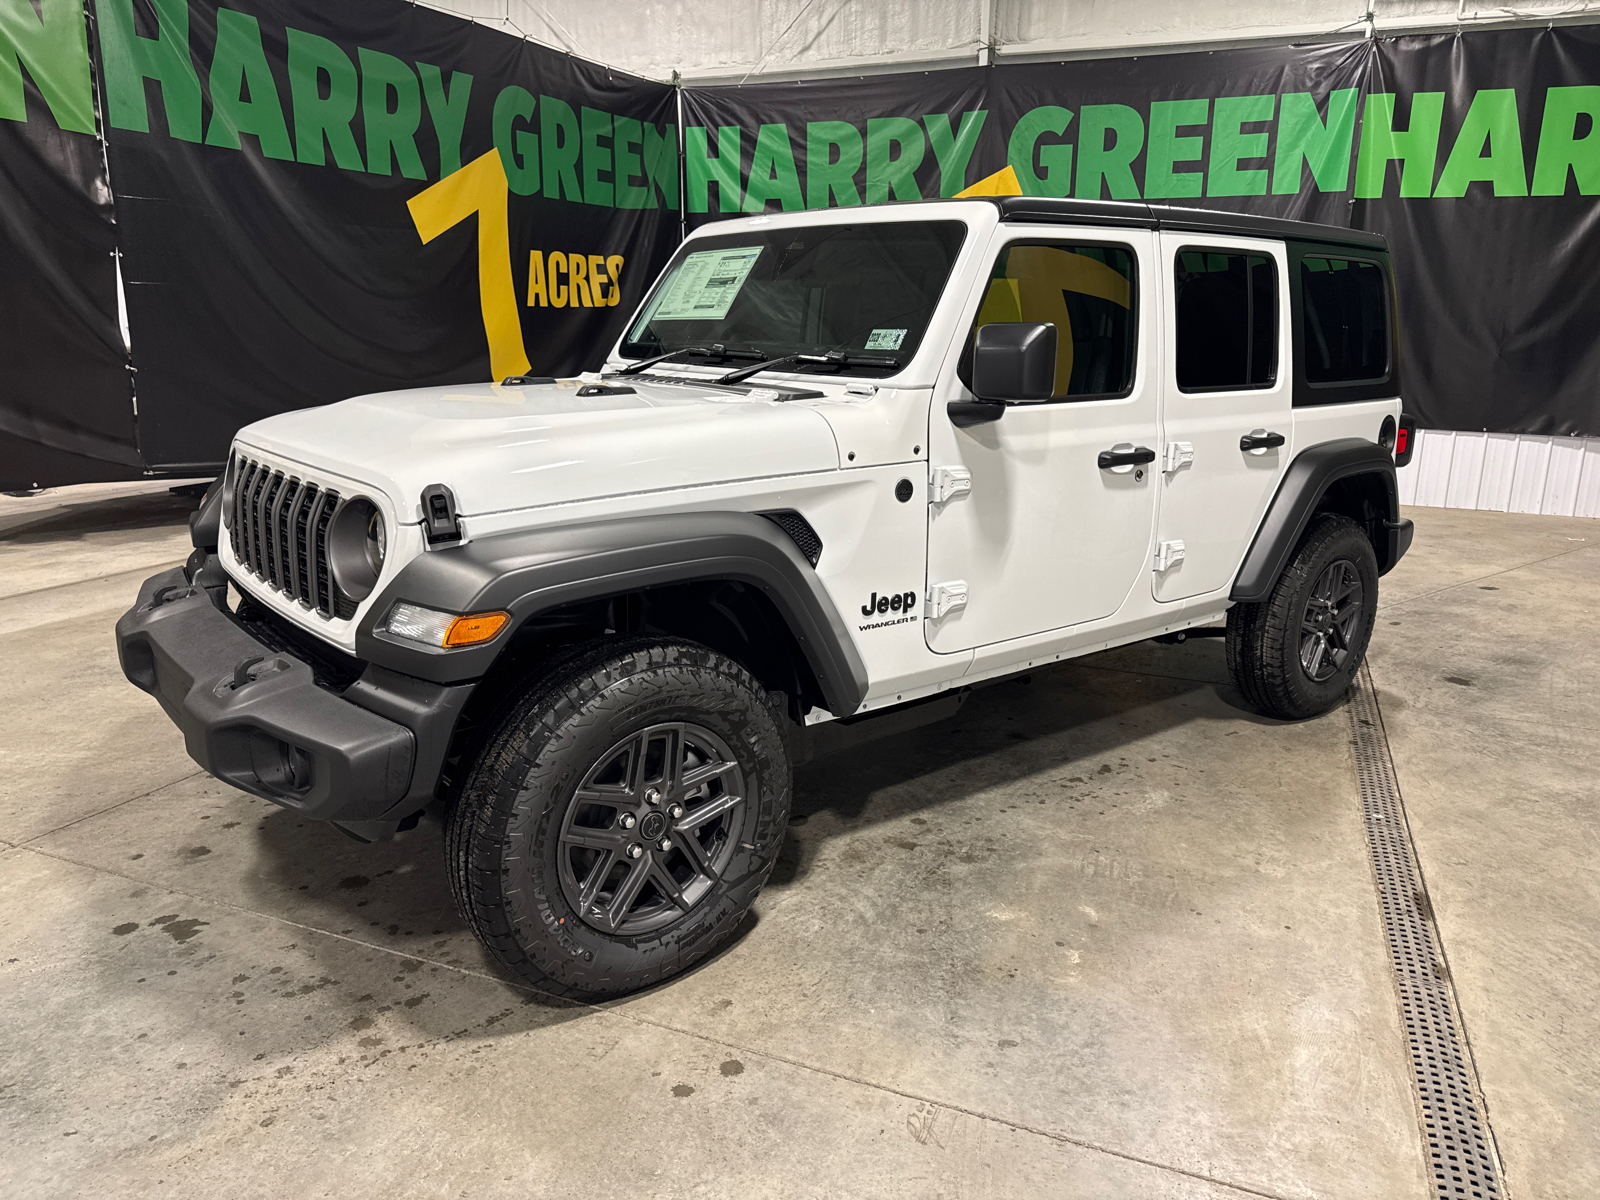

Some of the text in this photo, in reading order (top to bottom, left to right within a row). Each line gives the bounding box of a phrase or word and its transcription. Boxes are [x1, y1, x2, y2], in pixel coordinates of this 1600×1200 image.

[95, 0, 679, 210] HARRY GREEN
[685, 87, 1359, 213] HARRY GREEN
[1354, 85, 1600, 199] HAR
[406, 147, 532, 382] 7
[527, 249, 625, 308] ACRES
[859, 617, 909, 631] WRANGLER
[861, 591, 916, 615] Jeep
